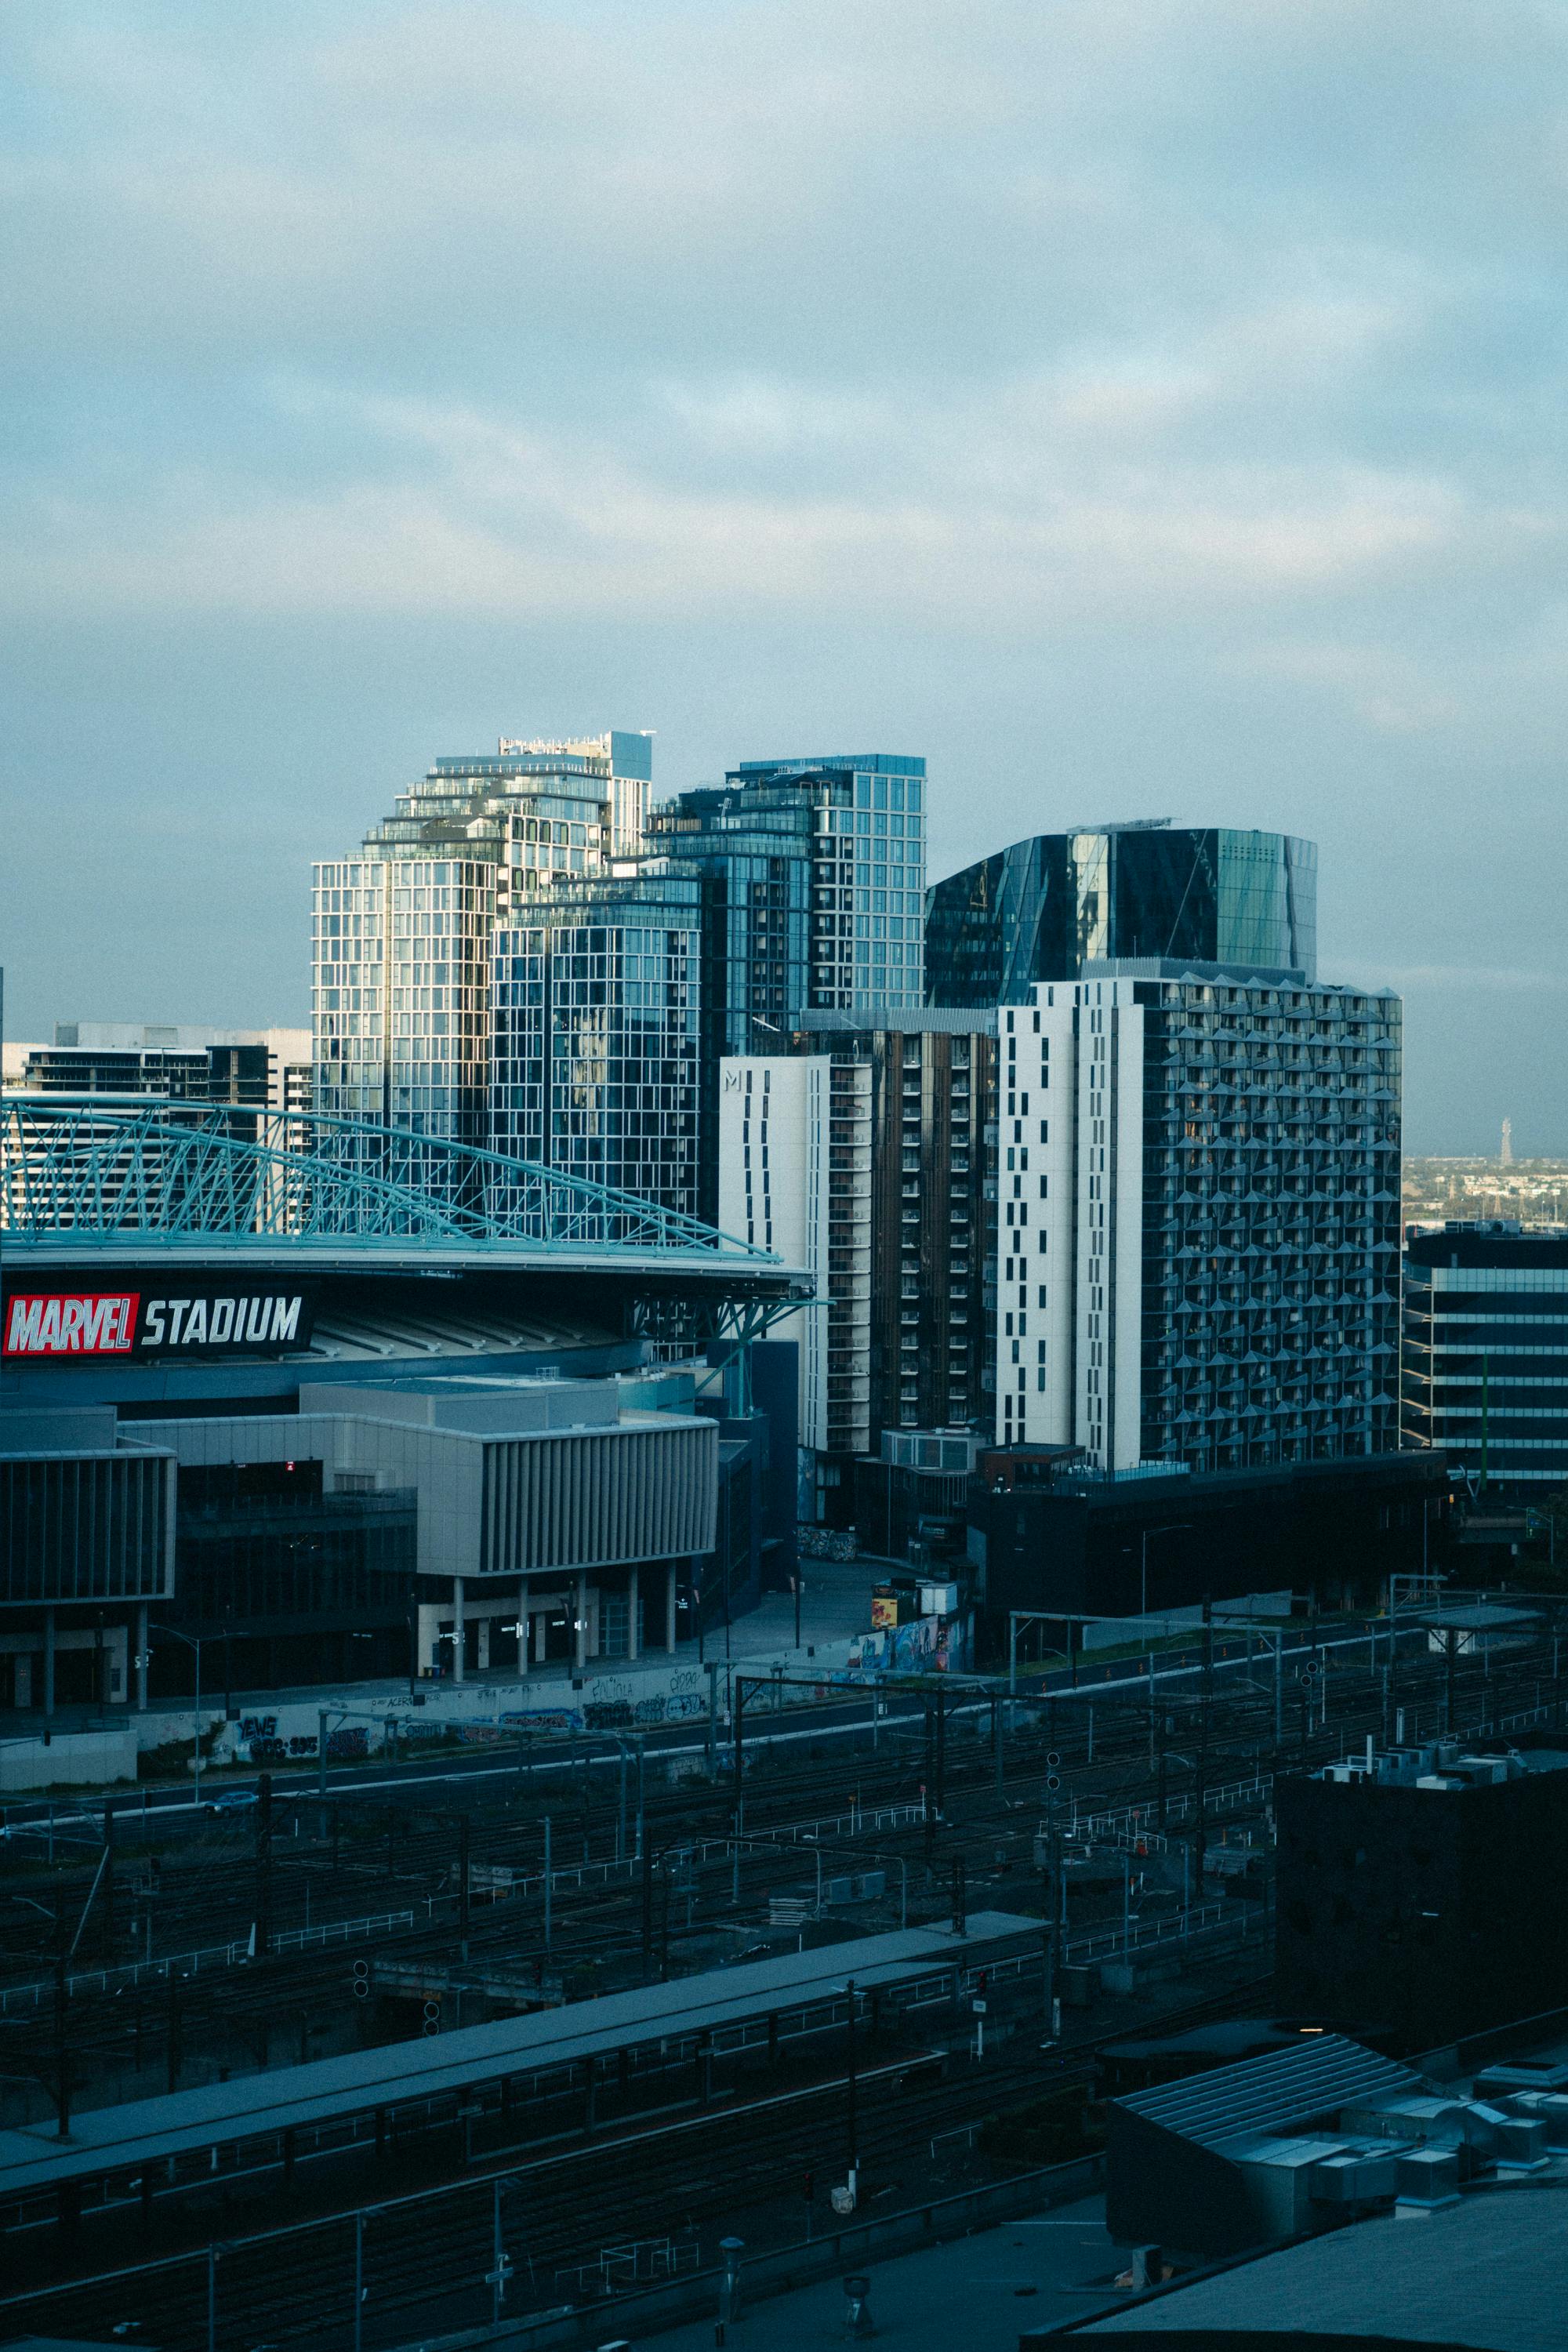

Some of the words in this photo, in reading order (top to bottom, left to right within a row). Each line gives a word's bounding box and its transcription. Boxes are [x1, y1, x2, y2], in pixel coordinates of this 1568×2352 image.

[725, 1069, 742, 1092] M
[8, 1298, 130, 1352] MARVEL
[141, 1296, 303, 1346] STADIUM
